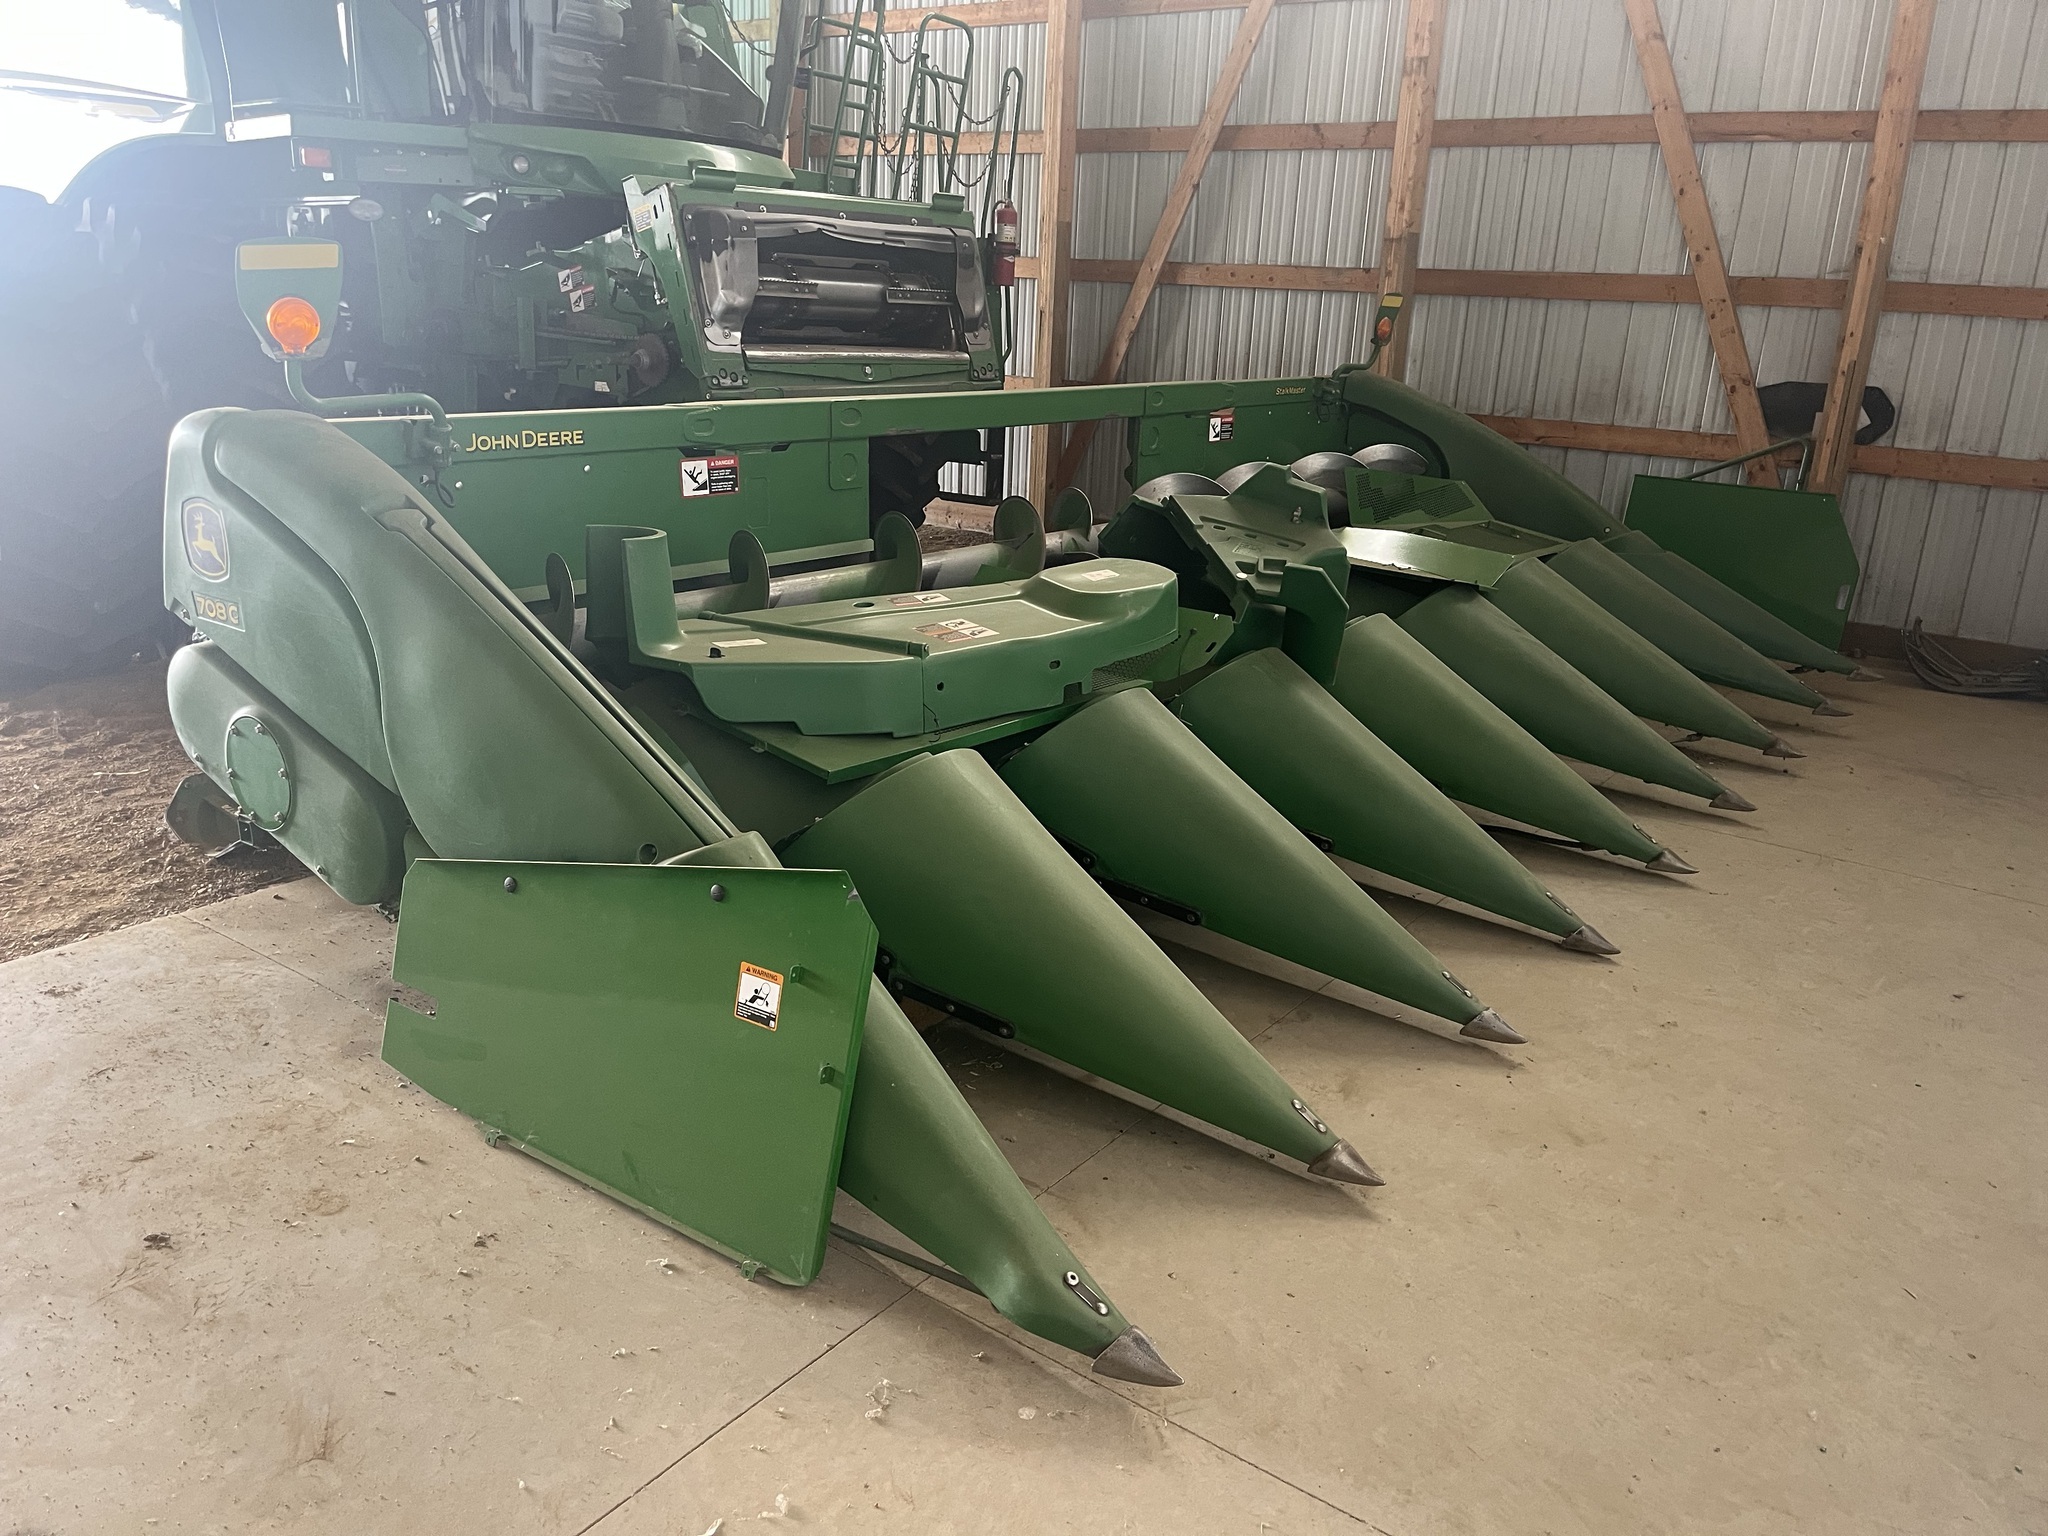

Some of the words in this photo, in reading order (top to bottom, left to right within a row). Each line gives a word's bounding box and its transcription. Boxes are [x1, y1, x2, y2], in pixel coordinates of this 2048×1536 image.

[465, 433, 520, 452] JOHN
[521, 430, 584, 449] DEERE
[196, 596, 239, 625] 708C
[751, 967, 778, 982] WARNING
